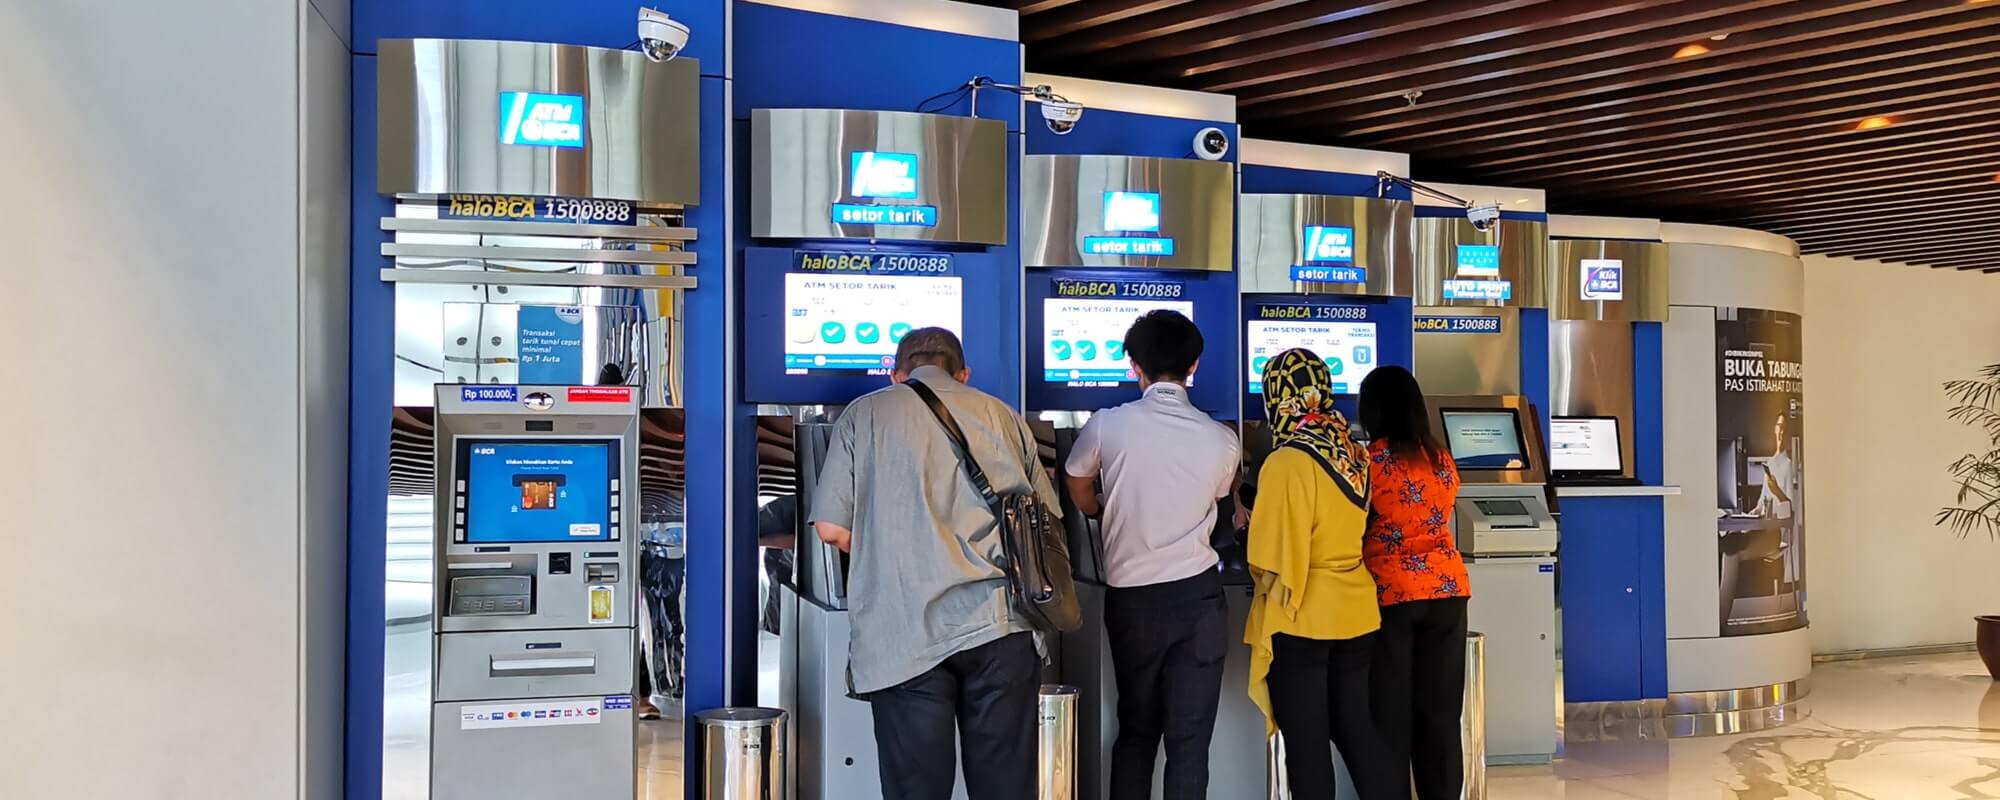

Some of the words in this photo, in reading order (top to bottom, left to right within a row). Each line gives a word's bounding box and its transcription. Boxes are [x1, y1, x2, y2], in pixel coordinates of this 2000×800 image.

[449, 200, 536, 219] haloBCA
[543, 202, 631, 222] 1500888
[842, 208, 884, 222] setor
[889, 209, 926, 223] tarik
[1092, 240, 1129, 254] setor
[1133, 240, 1164, 254] tarik
[801, 254, 872, 271] haloBCA
[877, 256, 949, 272] 1500888
[1298, 269, 1329, 280] setor
[1332, 268, 1358, 280] tarik
[1058, 281, 1117, 297] haloBCA
[1122, 283, 1182, 298] 1500888
[1260, 305, 1312, 319] haloBCA
[1315, 306, 1367, 320] 1500888
[1413, 318, 1449, 330] aloBCA
[1452, 319, 1498, 331] 1500888
[522, 329, 555, 337] Transaksi
[521, 345, 552, 353] minimal
[535, 354, 540, 362] 1
[1724, 358, 1766, 377] BUKA
[1724, 378, 1745, 392] PAS
[1746, 378, 1785, 393] ISTIRAHAT
[464, 389, 477, 401] Rp
